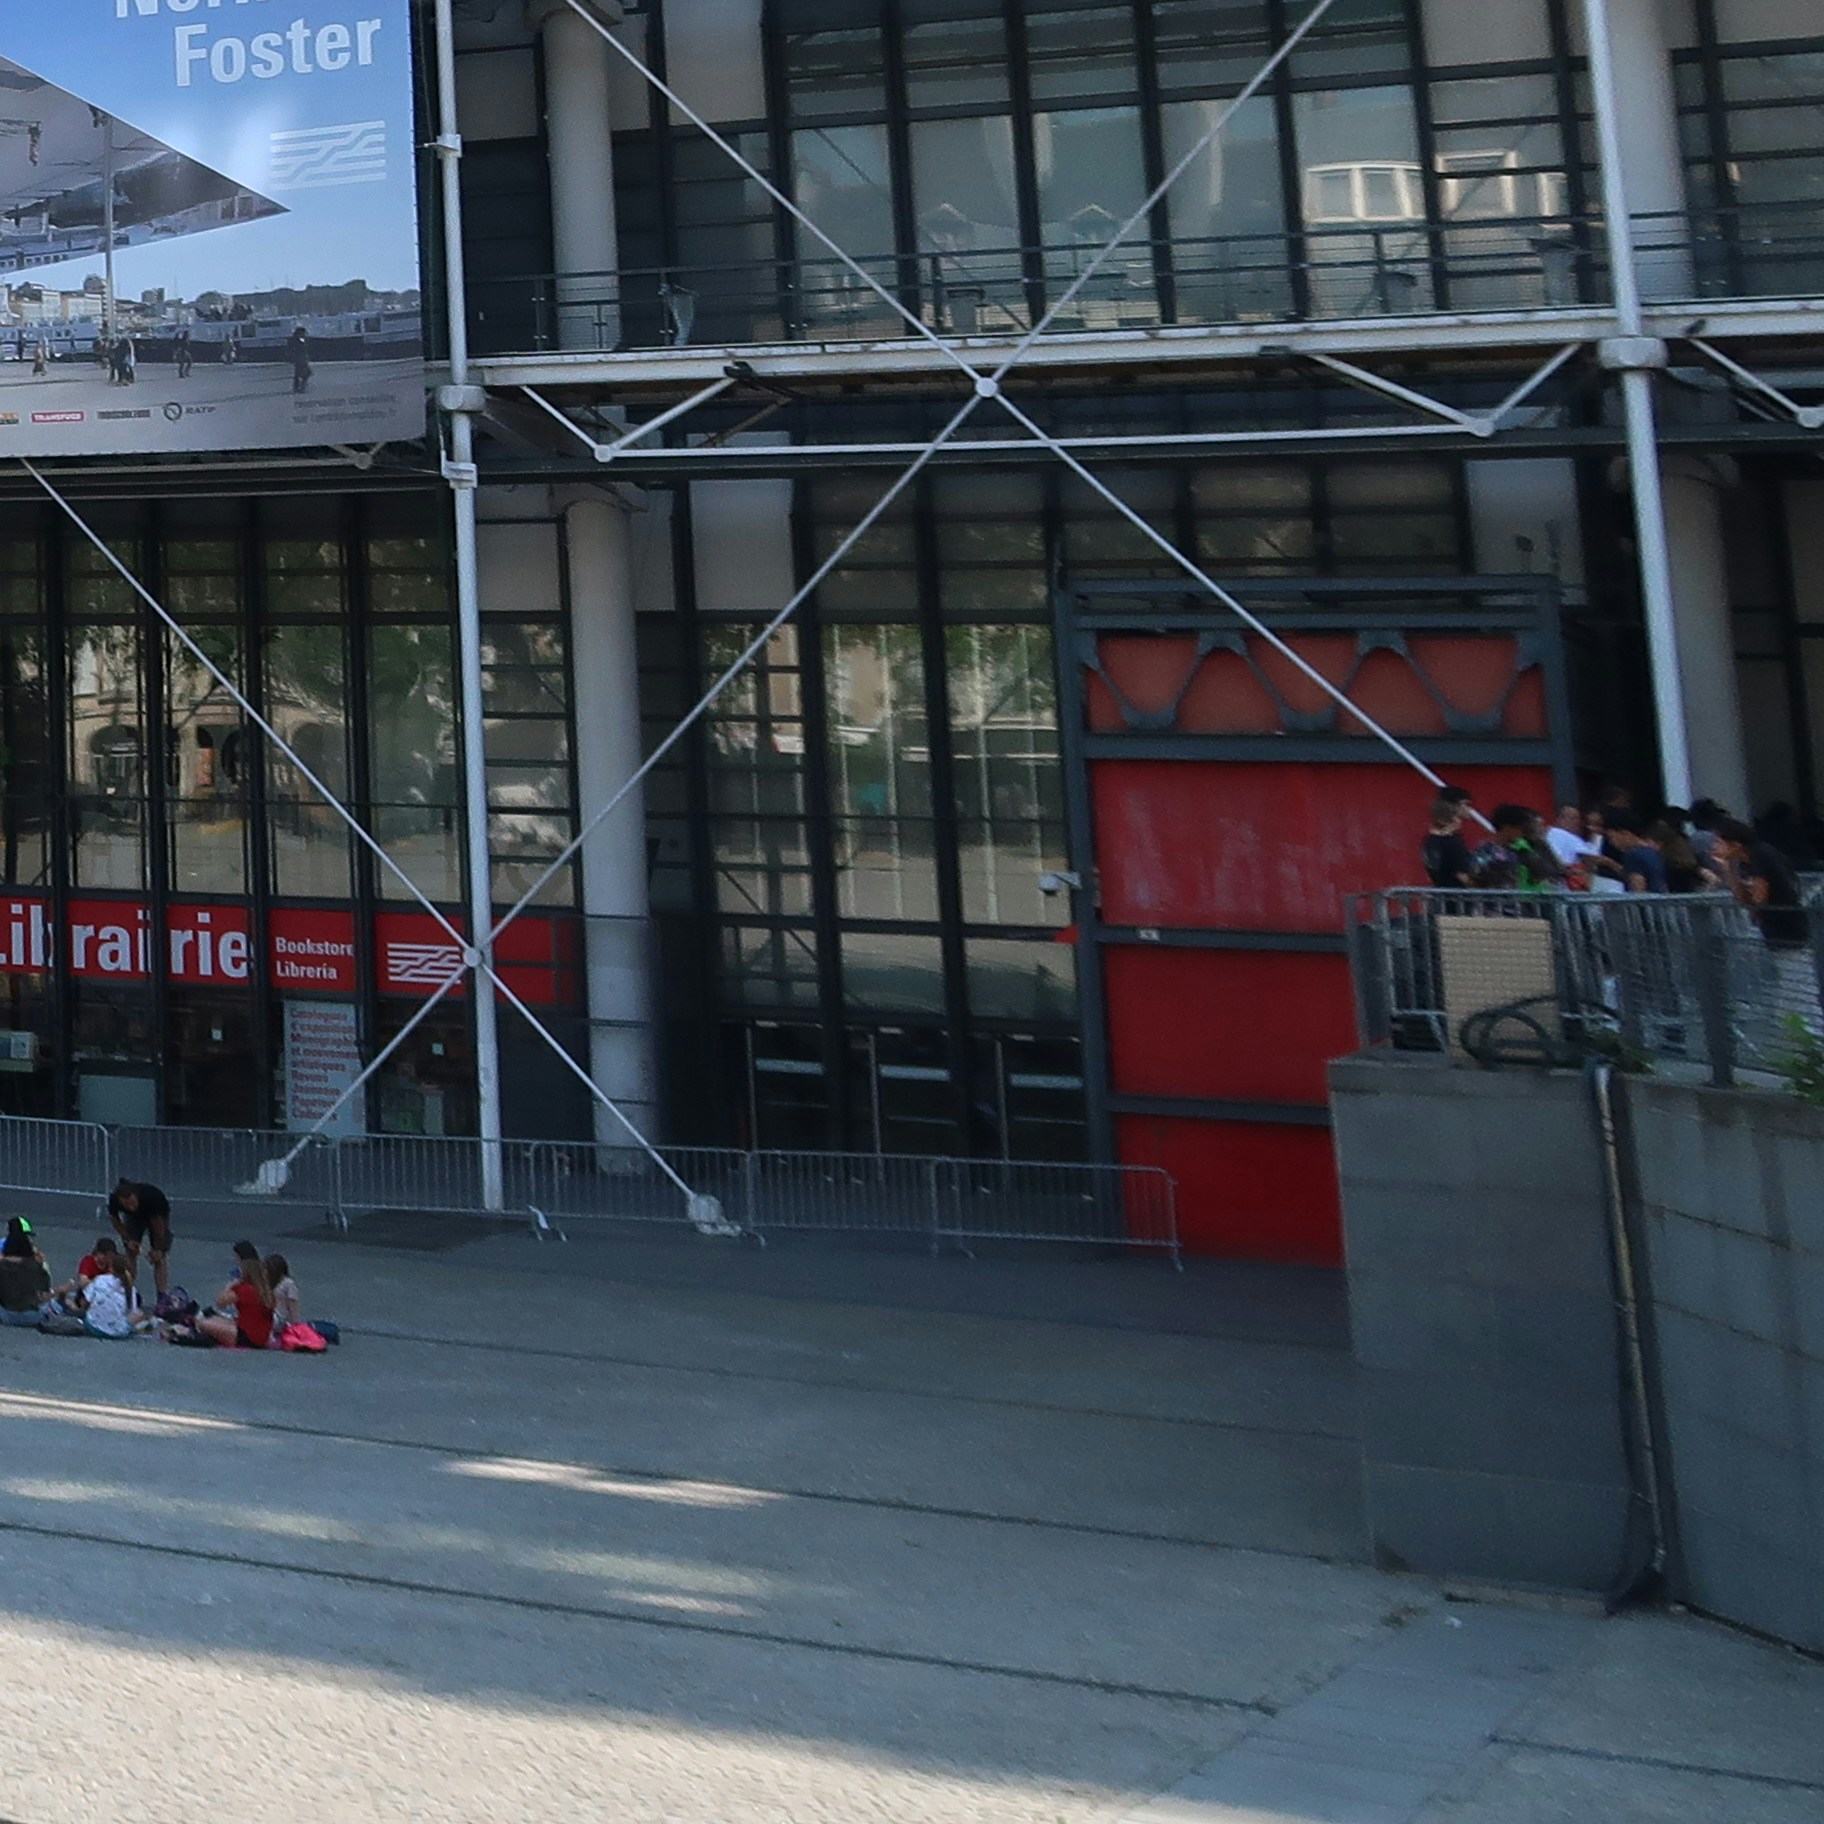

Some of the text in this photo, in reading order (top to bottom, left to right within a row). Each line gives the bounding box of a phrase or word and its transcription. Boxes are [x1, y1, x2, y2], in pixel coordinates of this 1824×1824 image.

[174, 18, 382, 87] Foster
[275, 937, 355, 957] Bookstore
[276, 961, 337, 980] Librería
